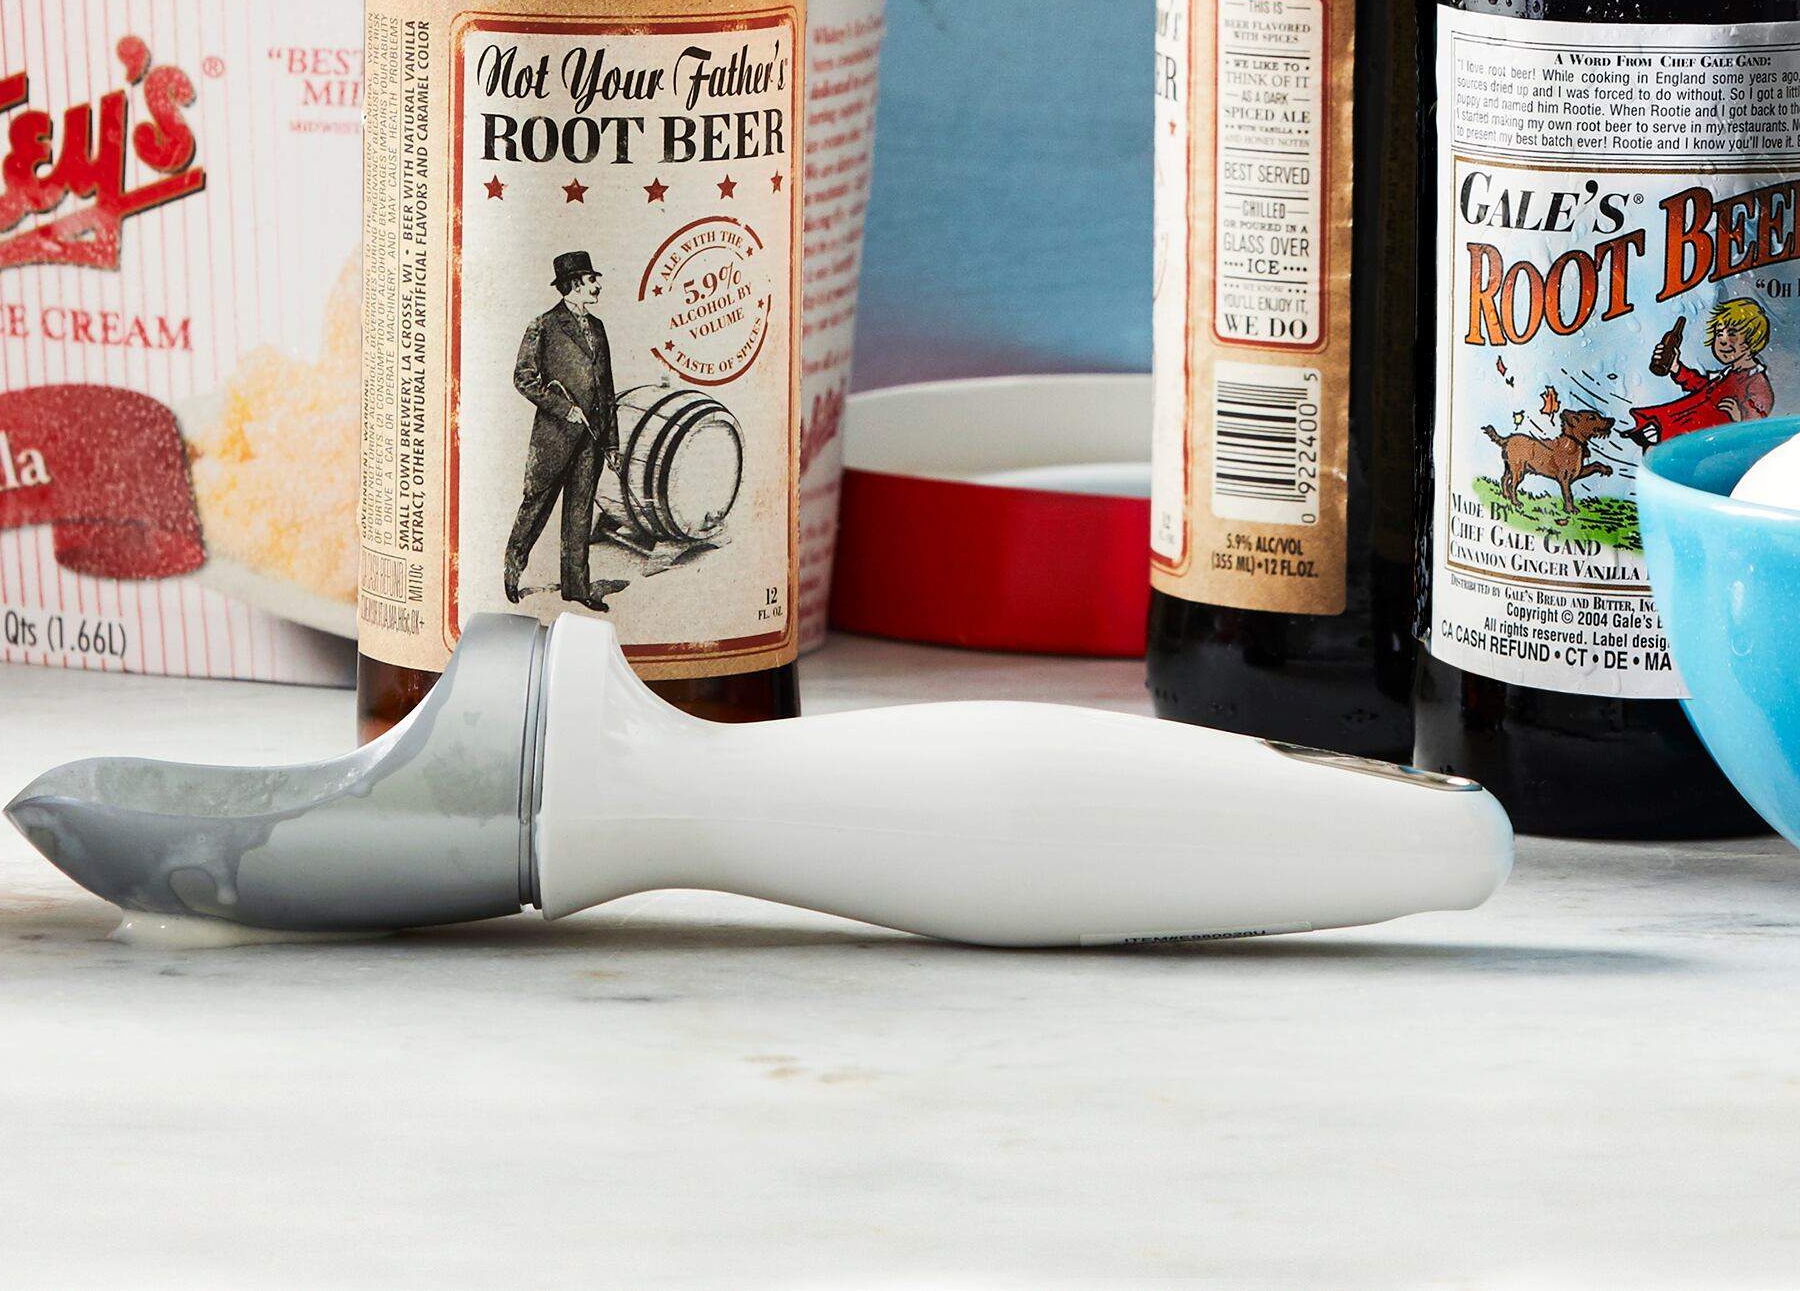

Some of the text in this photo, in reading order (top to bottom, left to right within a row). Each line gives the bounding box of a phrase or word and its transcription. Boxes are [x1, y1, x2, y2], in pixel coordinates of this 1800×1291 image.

[404, 20, 416, 82] VANILLA
[417, 21, 430, 71] COLOR
[1554, 53, 1772, 68] A WORD FROM CHEF GALE GAND:
[477, 39, 787, 115] Not Your Father's
[1542, 69, 1777, 87] While cooking in England some years
[404, 87, 415, 154] NATURAL
[417, 75, 429, 141] CARAMEL
[480, 109, 785, 165] ROOT BEER
[404, 160, 414, 201] WITH
[417, 147, 428, 179] AND
[1224, 161, 1310, 185] BEST SERVED
[403, 205, 413, 241] BEER
[416, 183, 428, 245] FLAVORS
[1242, 200, 1286, 219] CHILLED
[1459, 170, 1631, 235] GALE'S
[660, 231, 743, 282] ALE WITH THE
[1224, 232, 1309, 257] GLASS OVER
[1247, 258, 1280, 275] ICE
[402, 263, 413, 284] WI
[414, 249, 428, 325] ARTIFICIAL
[683, 261, 742, 305] 5.9%
[1464, 228, 1646, 348] ROOT
[669, 282, 752, 329] ALCOHOL BY
[689, 307, 745, 340] VOLUME
[1224, 313, 1308, 340] WE DO
[41, 305, 193, 351] CREAM
[414, 328, 425, 364] AND
[676, 317, 761, 375] TASTE OF SPICES
[401, 354, 412, 373] LA
[414, 368, 425, 433] NATURAL
[400, 453, 410, 498] TOWN
[413, 438, 424, 486] OTHER
[399, 503, 410, 551] SMALL
[1451, 492, 1509, 523] MADE BY
[1227, 533, 1304, 556] 5.9% ALC/VOL
[1451, 515, 1602, 556] CHEF GALE GAND
[1450, 540, 1640, 581] CINNAMON GINGER VANILLA
[767, 587, 777, 605] 12
[4, 607, 38, 646] Qts
[47, 613, 128, 657] (1.66L)
[1441, 620, 1672, 671] CA CASH REFUND CT DE MA
